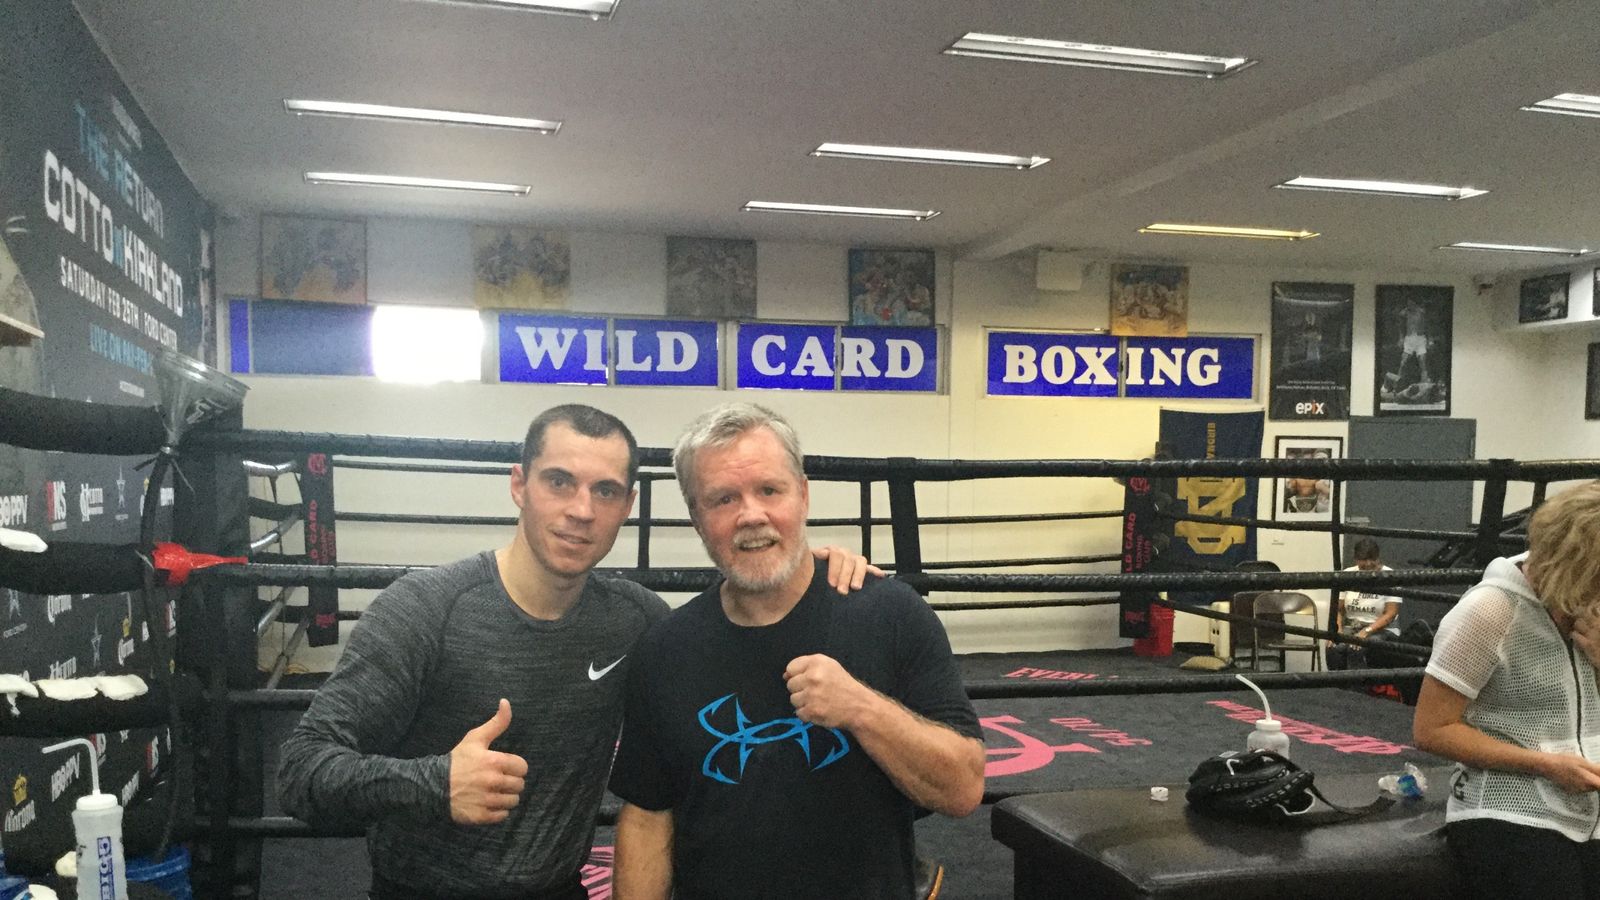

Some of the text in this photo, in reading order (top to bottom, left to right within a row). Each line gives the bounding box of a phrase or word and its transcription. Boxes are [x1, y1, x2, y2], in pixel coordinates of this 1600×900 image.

[43, 150, 114, 265] COTTO
[122, 224, 183, 318] KIRKLAND
[60, 255, 106, 310] SATURDAY
[107, 286, 121, 319] FEB
[122, 296, 139, 330] 25TH
[515, 326, 1222, 387] WILD CARD BOXING
